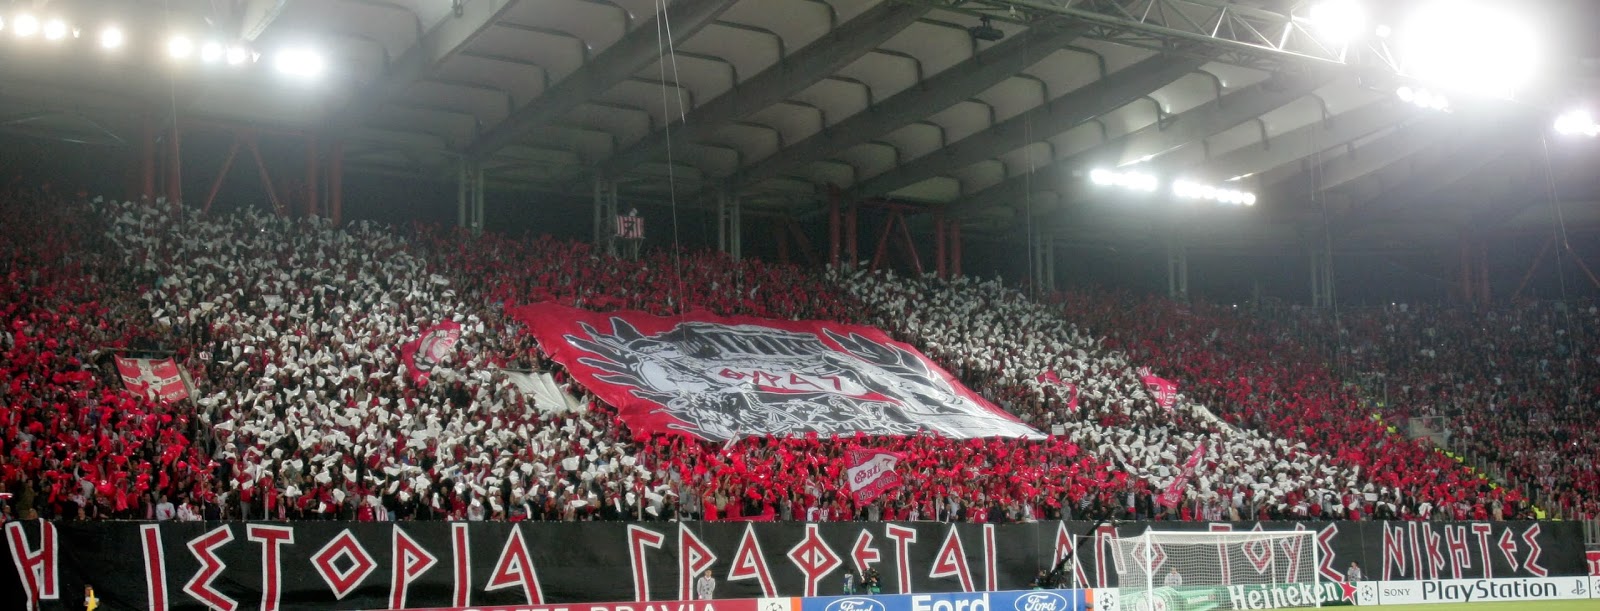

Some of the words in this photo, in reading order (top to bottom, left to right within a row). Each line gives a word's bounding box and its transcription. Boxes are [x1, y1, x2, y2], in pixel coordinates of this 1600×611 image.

[140, 522, 545, 611] ΙΣΤΟΡΙΑ
[627, 521, 998, 603] ΓΡΑΦΕΤΑΙ
[1209, 521, 1345, 584] ΤΟΥΣ
[1381, 519, 1549, 581] ΝΙΚΗΤΕΣ
[911, 593, 989, 611] Ford
[1025, 595, 1057, 611] Ford
[1227, 581, 1339, 610] Heineken
[1384, 588, 1410, 597] SONY
[1422, 579, 1557, 603] PlayStation
